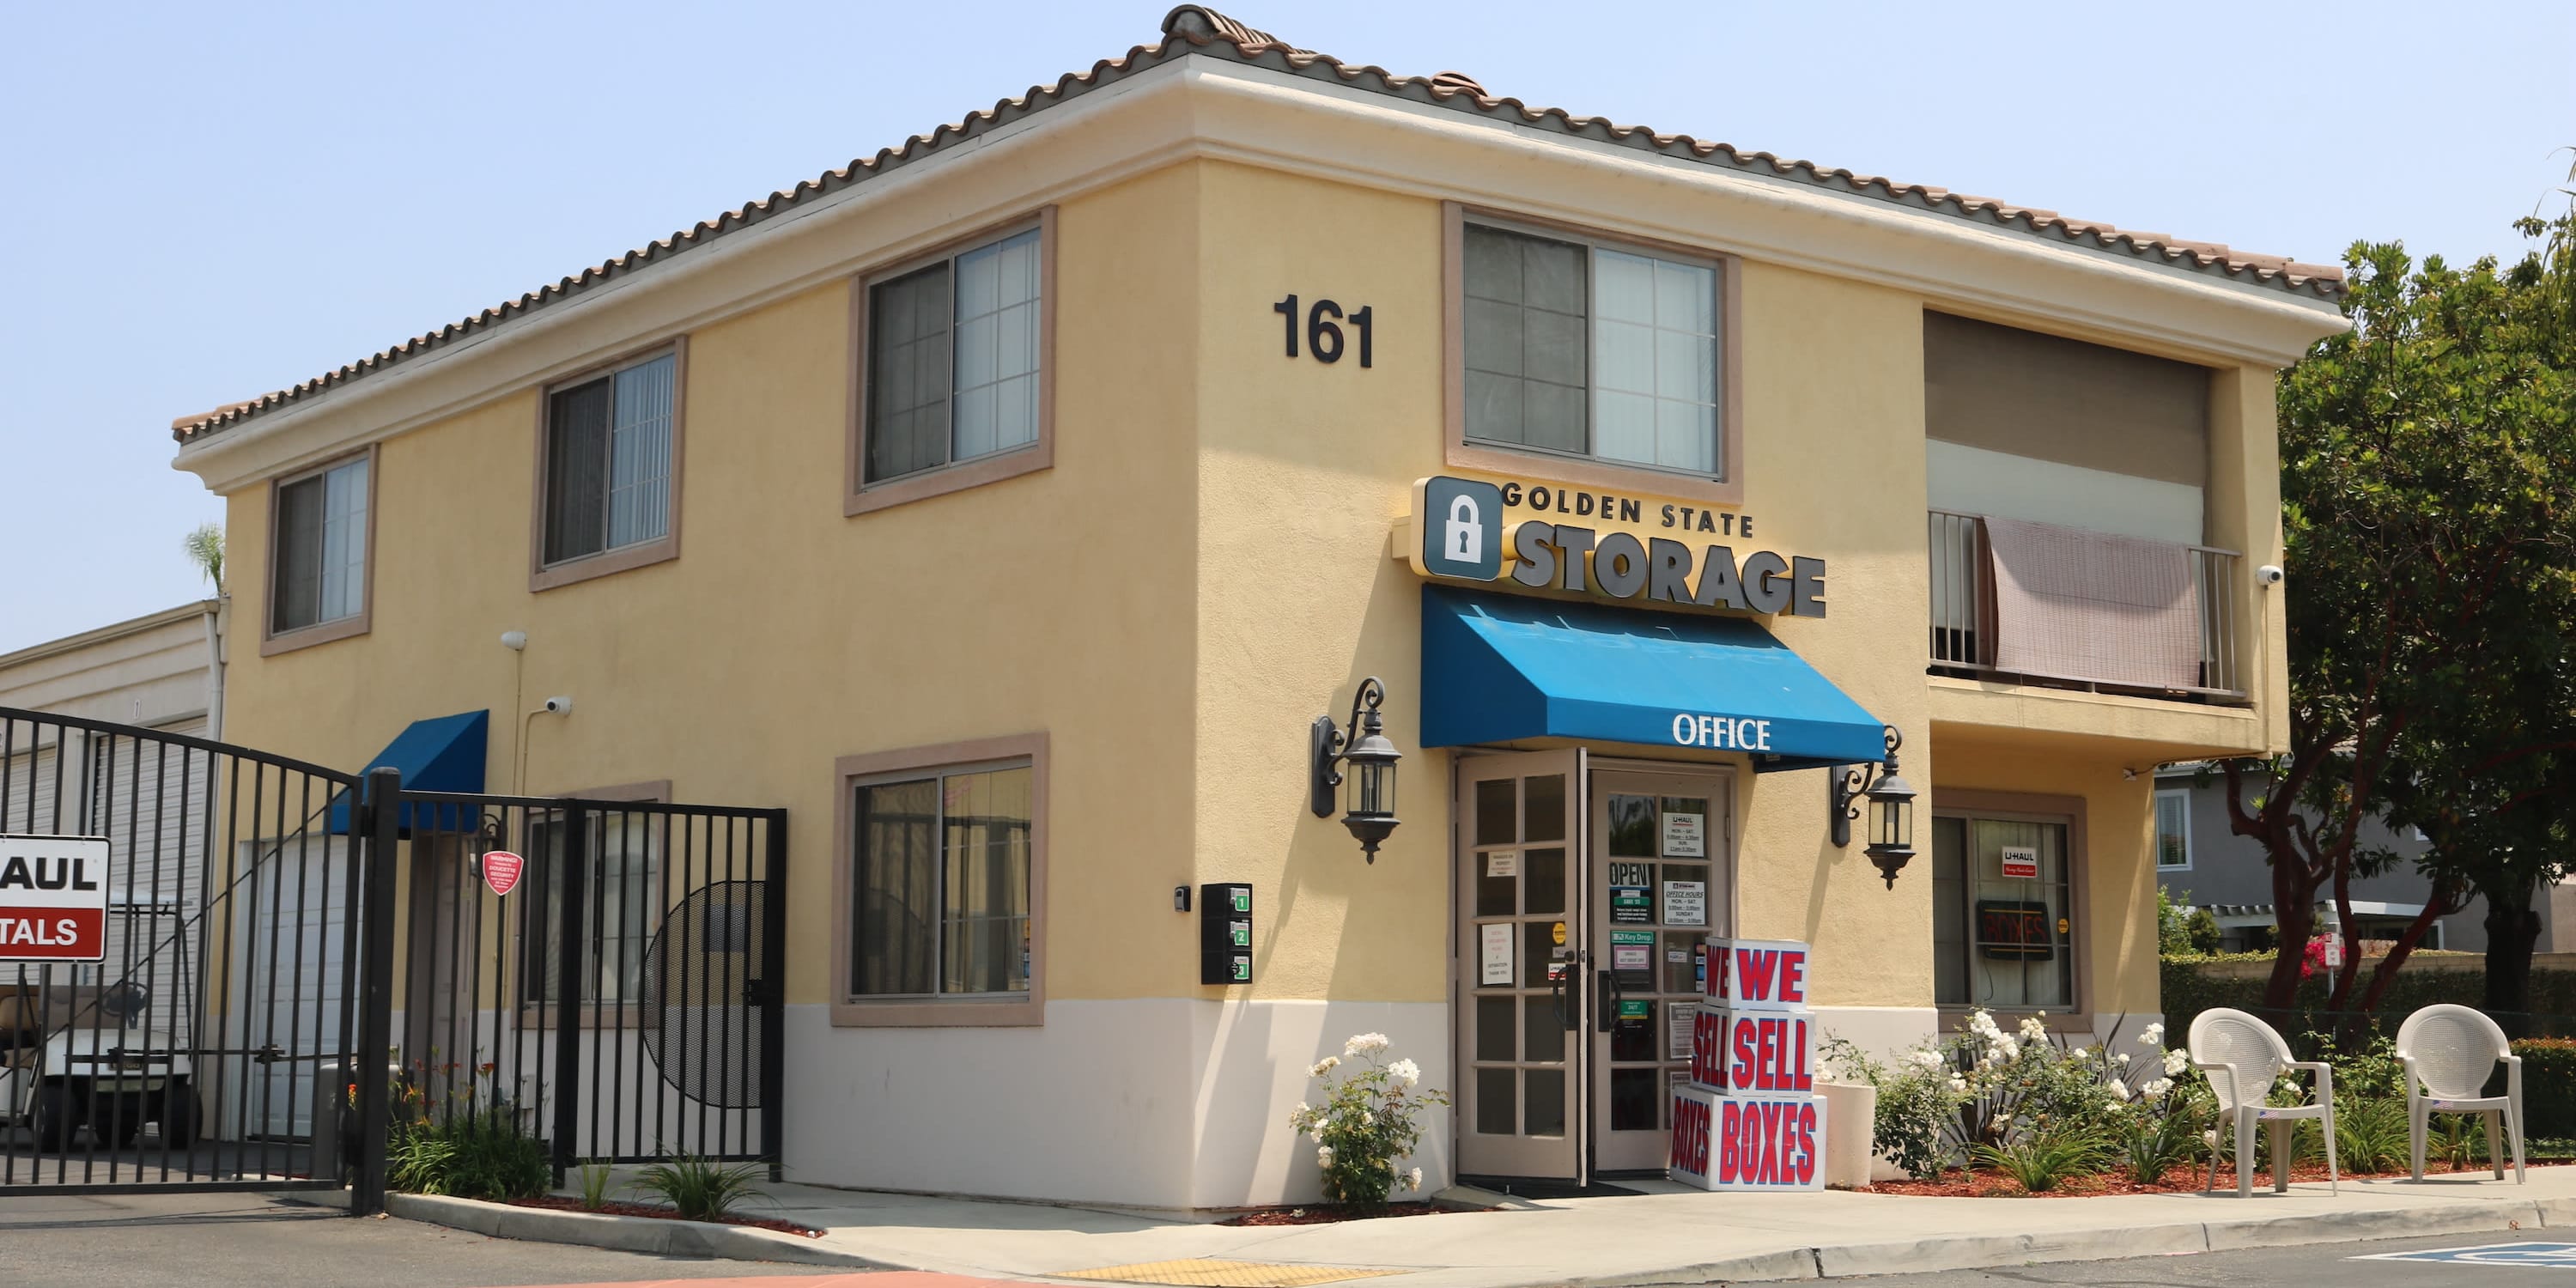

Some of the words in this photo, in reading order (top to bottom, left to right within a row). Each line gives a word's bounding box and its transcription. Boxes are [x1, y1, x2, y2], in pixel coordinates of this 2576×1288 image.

[1274, 294, 1371, 368] 161
[1501, 483, 1641, 523] GOLDEN
[1662, 504, 1753, 538] STATE
[1511, 520, 1826, 618] STORAGE
[1673, 713, 1771, 750] OFFICE
[1609, 862, 1648, 886] OPEN
[2005, 852, 2034, 861] U-HAUL
[1239, 897, 1244, 908] 1
[1239, 932, 1245, 942] 2
[1625, 933, 1637, 942] Key
[1637, 933, 1651, 942] Drop
[1239, 966, 1245, 975] 3
[1706, 945, 1730, 999] WE
[1735, 948, 1806, 1003] WE
[1692, 1011, 1728, 1090] SELL
[1732, 1017, 1813, 1092] SELL
[1671, 1096, 1710, 1177] BOXES
[1719, 1100, 1817, 1186] BOXES
